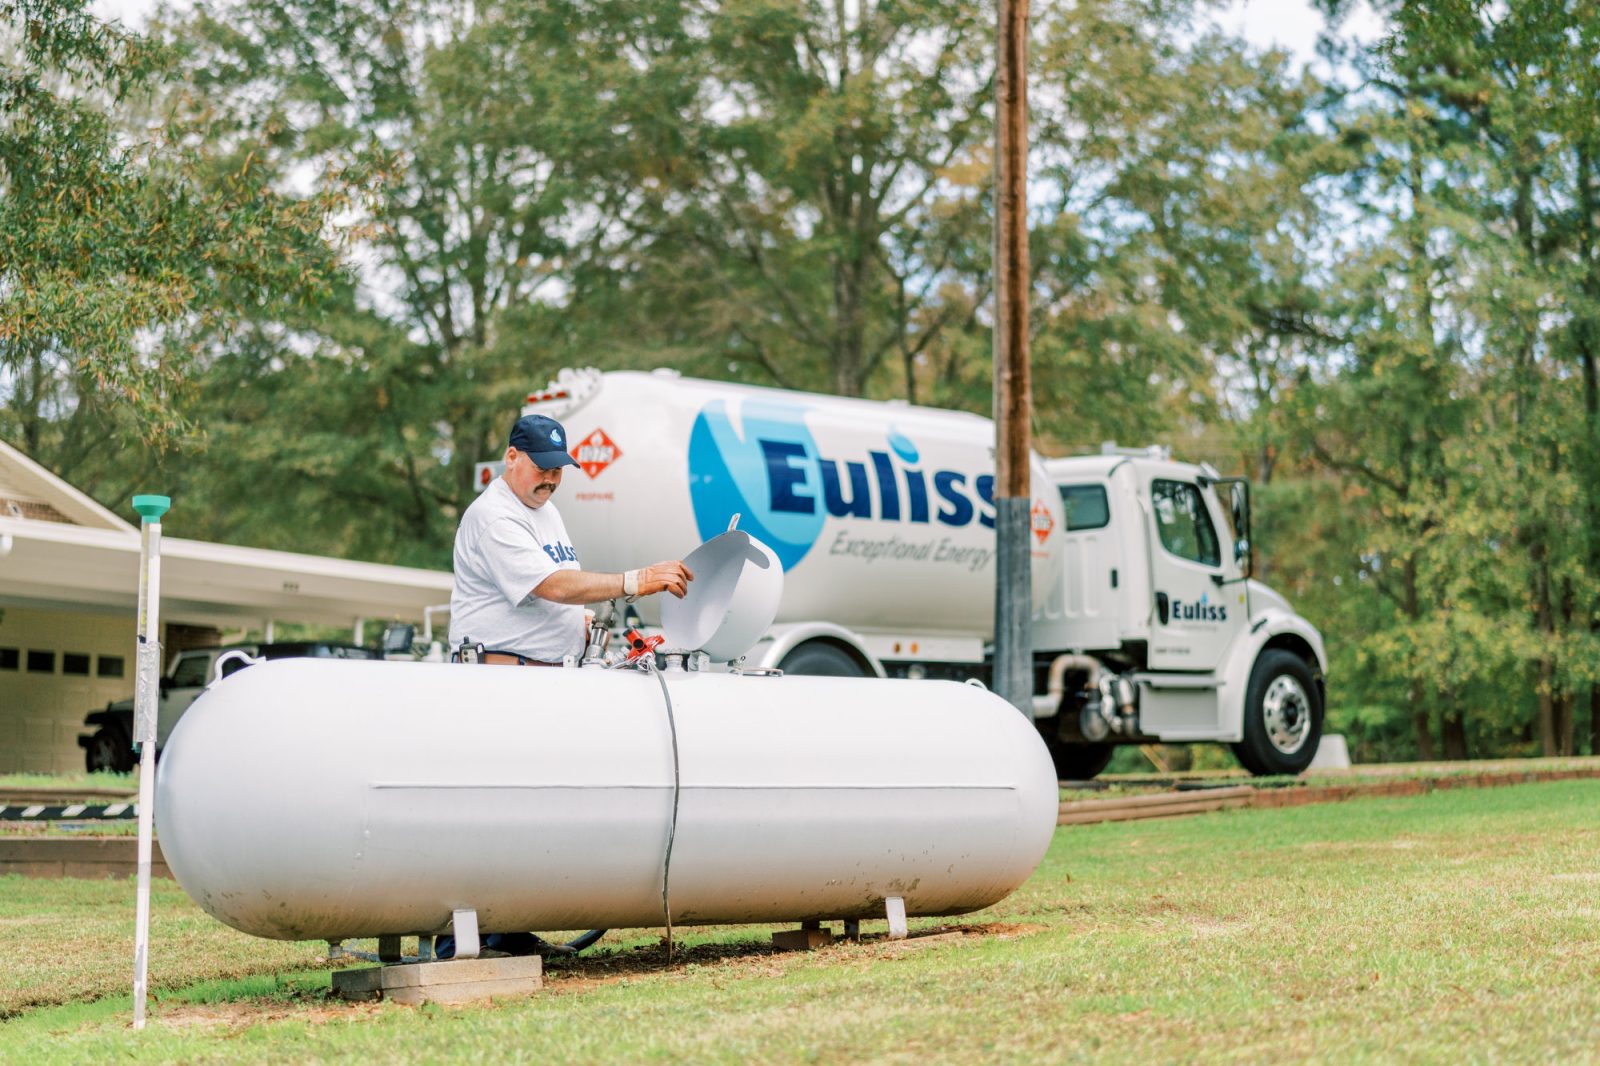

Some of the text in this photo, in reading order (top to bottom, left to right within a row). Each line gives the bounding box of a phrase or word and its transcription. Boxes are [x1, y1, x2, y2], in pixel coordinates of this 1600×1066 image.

[829, 530, 992, 571] Exceptional Energy
[1172, 595, 1227, 621] Euliss
